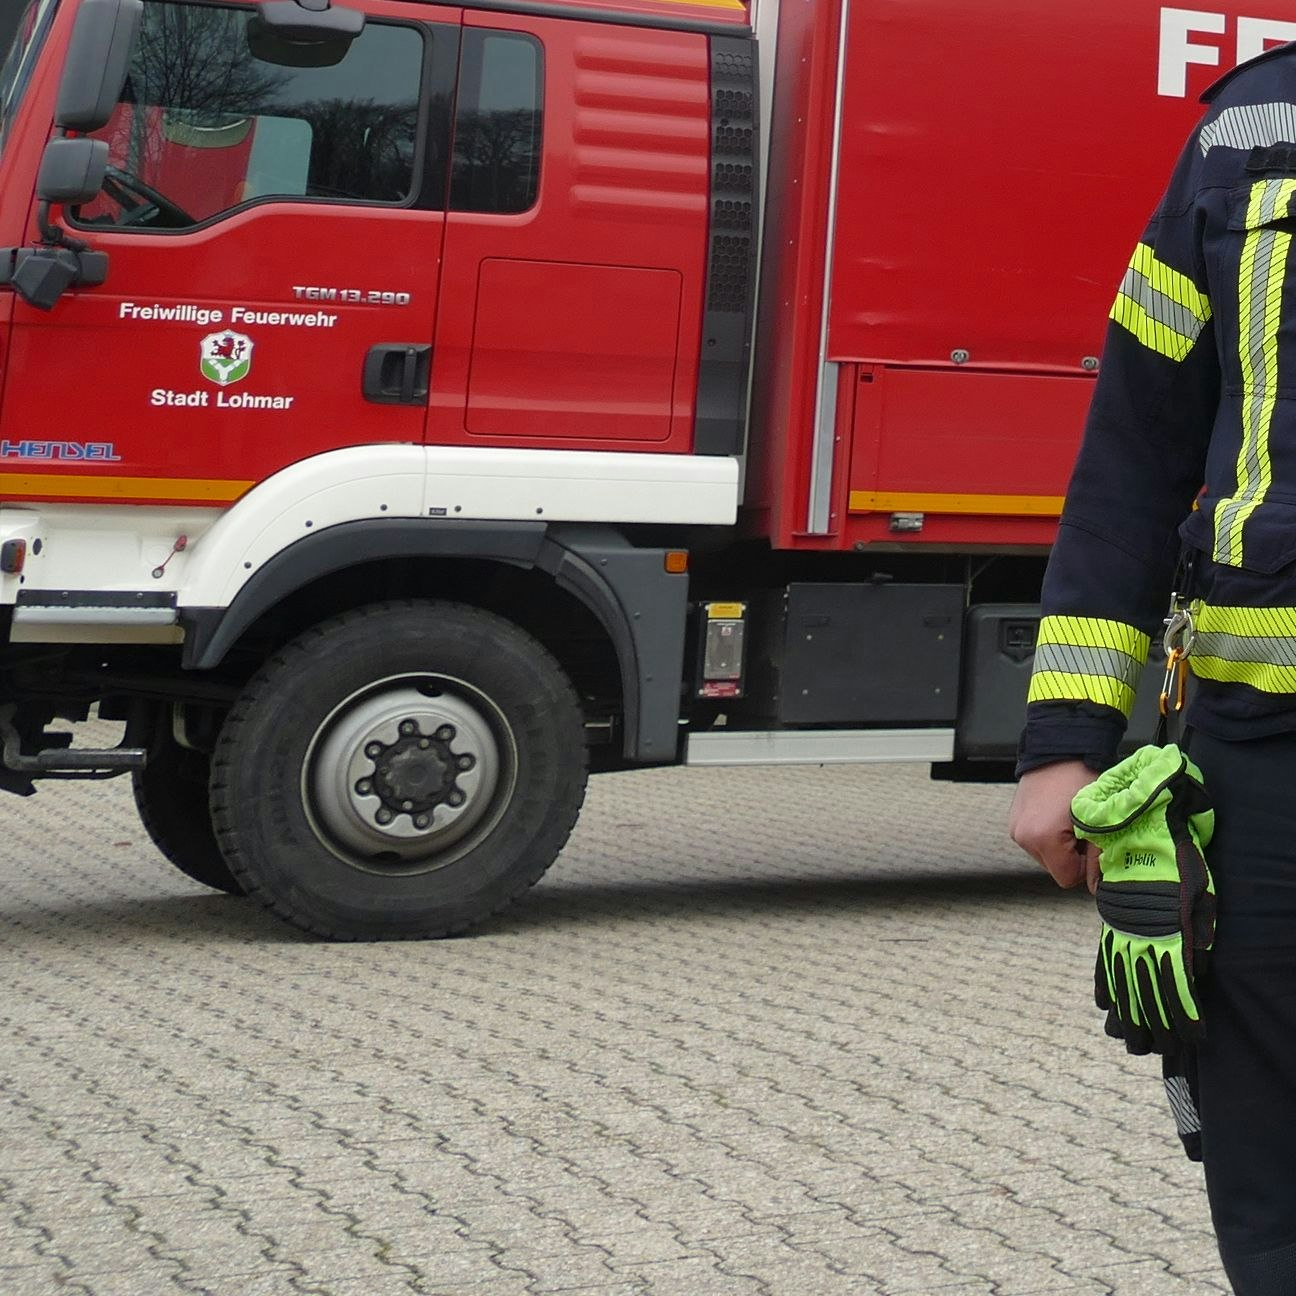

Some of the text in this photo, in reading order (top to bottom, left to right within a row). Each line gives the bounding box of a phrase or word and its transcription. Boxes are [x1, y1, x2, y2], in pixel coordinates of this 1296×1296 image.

[292, 286, 411, 305] TGM 13.290
[119, 302, 338, 328] Freiwillige Feuerwehr
[150, 389, 294, 410] Stadt Lohmar
[0, 439, 122, 461] HENSEL
